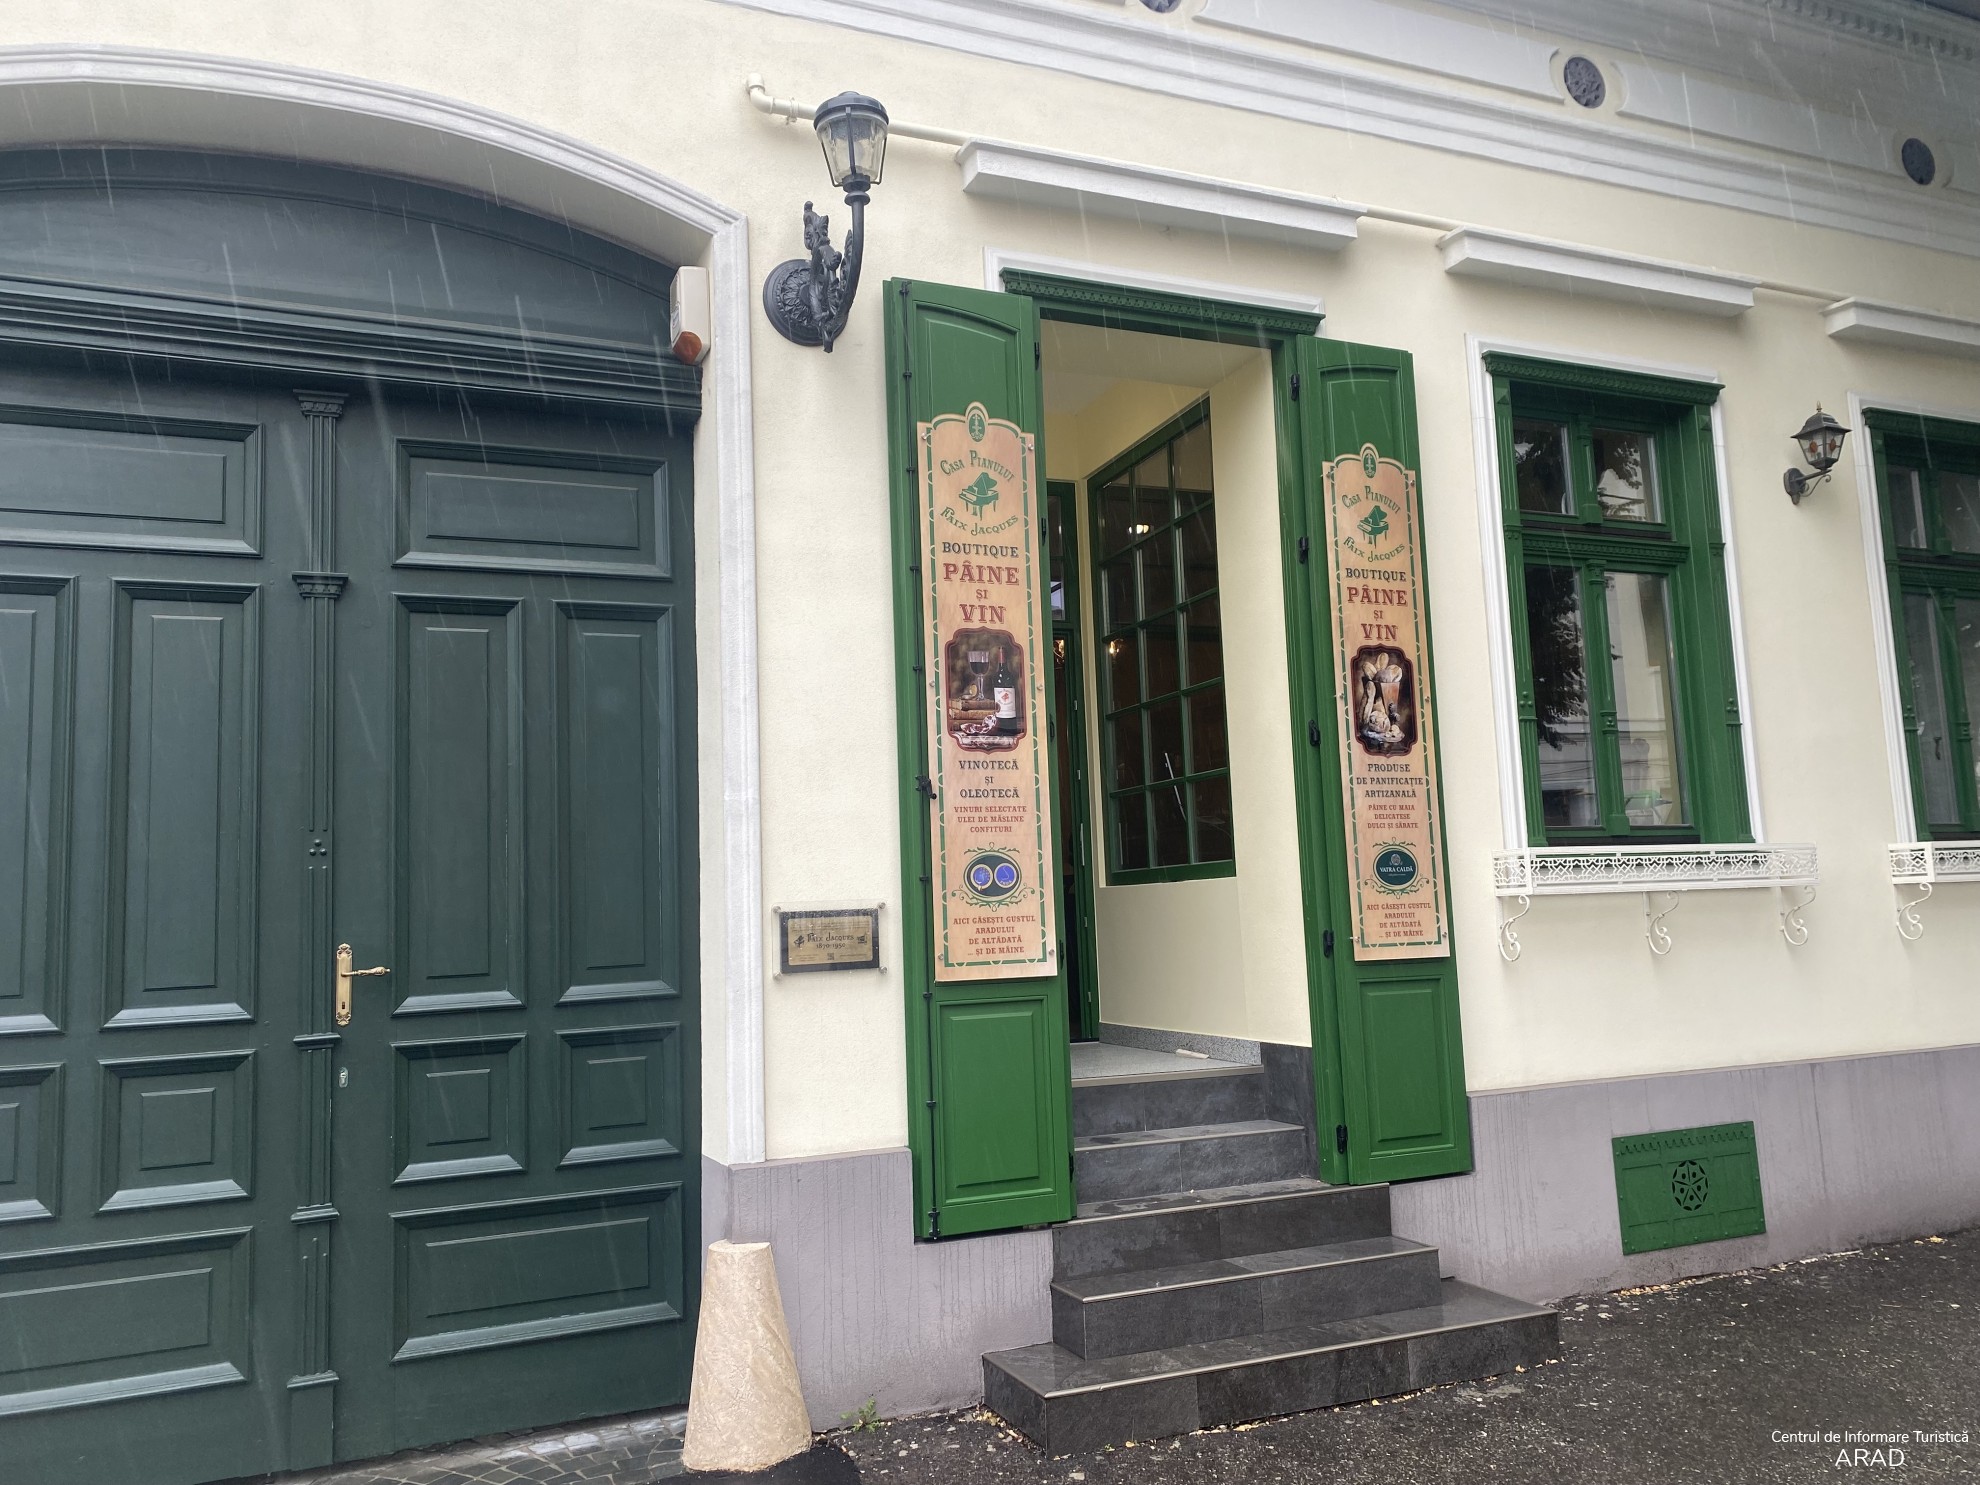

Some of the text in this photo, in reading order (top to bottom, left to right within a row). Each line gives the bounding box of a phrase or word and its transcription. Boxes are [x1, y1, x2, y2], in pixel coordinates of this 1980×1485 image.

[942, 542, 1019, 558] BOUTIQUE
[943, 560, 1020, 586] PÂINE
[1345, 568, 1407, 582] BOUTIQUE
[976, 588, 988, 601] ȘI
[1346, 584, 1408, 606] PÂINE
[959, 603, 1006, 624] VIN
[1373, 610, 1383, 620] ȘI
[1361, 623, 1399, 642] VIN
[958, 758, 1020, 770] VINOTECĂ
[1368, 764, 1411, 772] PRODUSE
[984, 776, 994, 786] ȘI
[1370, 778, 1424, 787] PANIFICAȚIE
[960, 786, 1020, 798] OLEOTECĂ
[1365, 789, 1417, 798] ARTIZANALĂ
[972, 916, 1004, 925] GĂSEȘTI
[975, 926, 1015, 934] ARADULUI
[982, 935, 1022, 944] ALTĂDATĂ
[998, 946, 1024, 954] MÂINE
